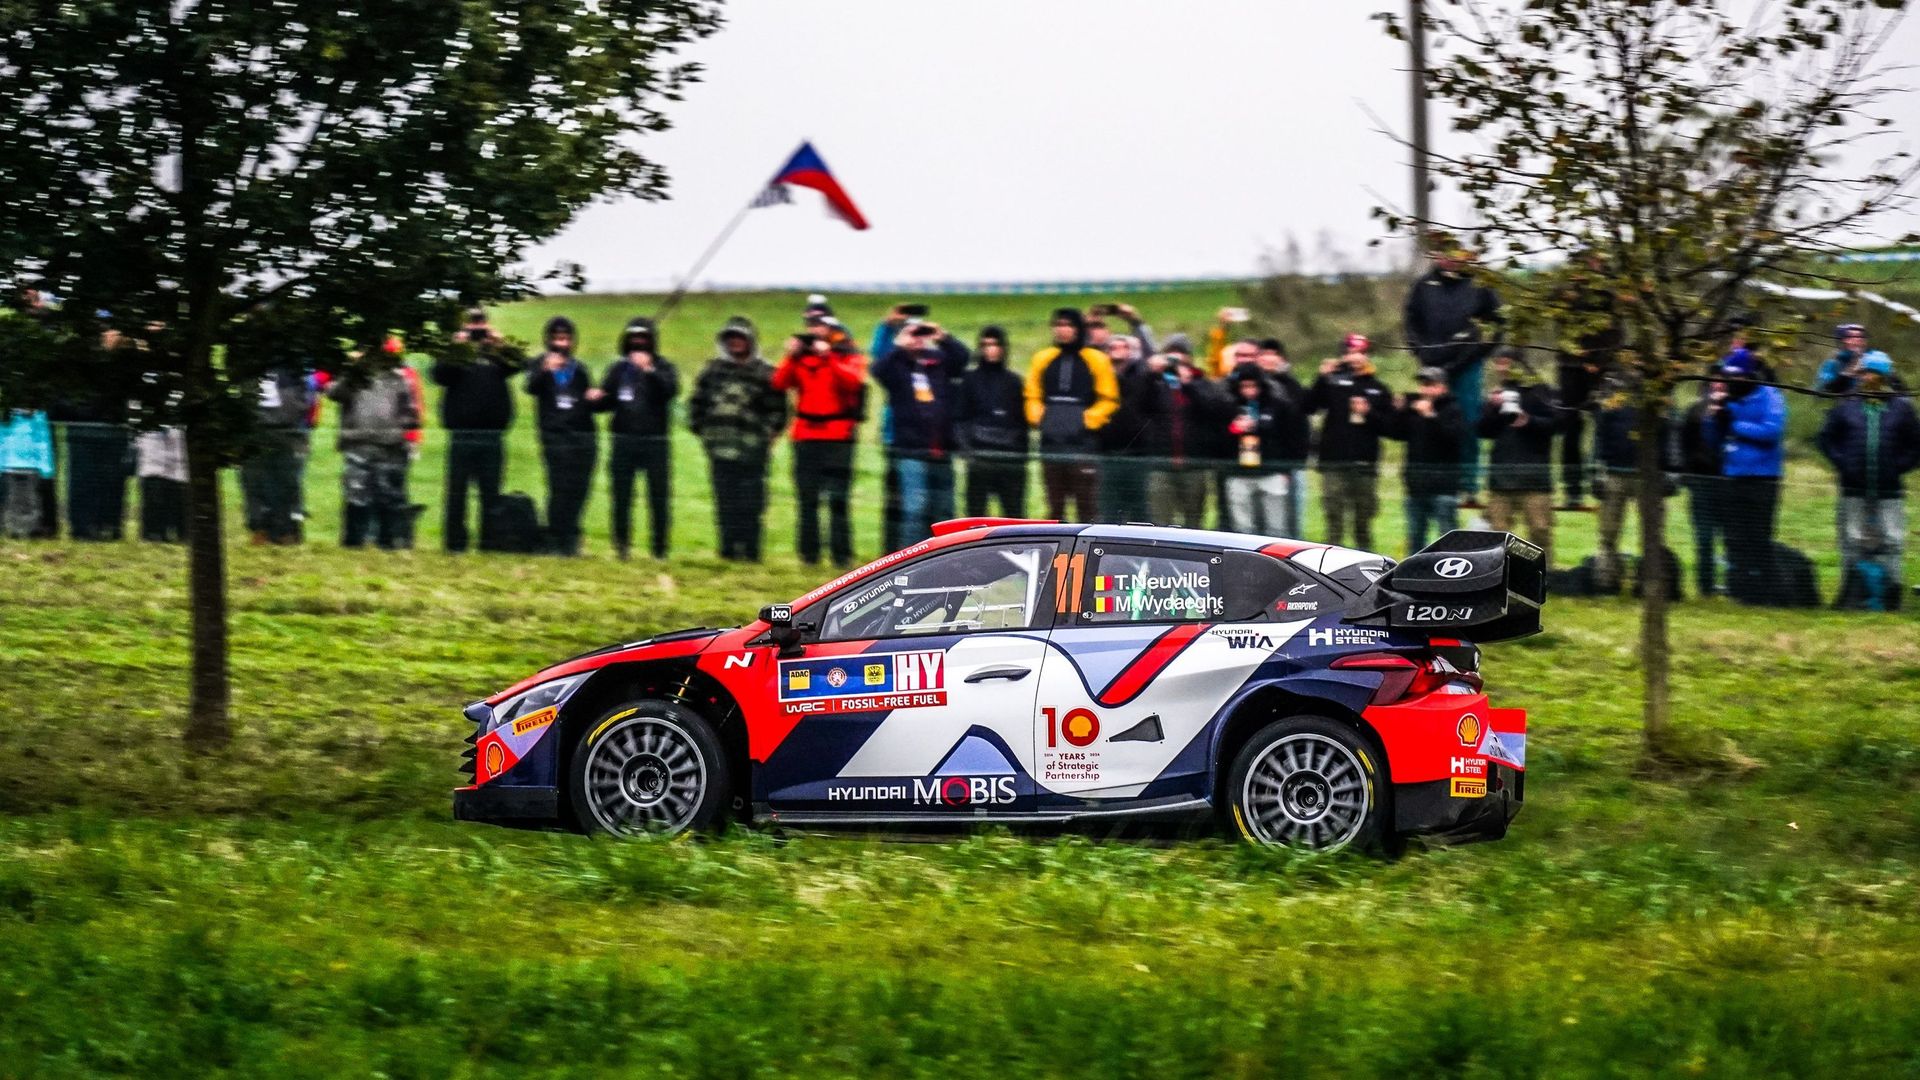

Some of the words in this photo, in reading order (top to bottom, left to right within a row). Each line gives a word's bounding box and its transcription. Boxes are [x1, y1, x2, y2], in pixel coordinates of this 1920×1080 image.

[808, 543, 929, 600] motorsport.hyundai.com
[859, 579, 894, 605] HYUNDAI
[1053, 553, 1085, 613] 11
[771, 606, 789, 619] ixo
[1335, 628, 1389, 638] HYUNDAI
[1335, 637, 1375, 645] STEEL
[790, 671, 809, 679] ADAC
[897, 652, 943, 691] HY
[786, 702, 826, 713] WRC
[841, 696, 910, 710] FOSSIL-FREE
[913, 694, 940, 705] FUEL
[516, 710, 553, 733] PIRELLI
[1046, 761, 1055, 770] of
[1058, 761, 1099, 771] Strategic
[1045, 772, 1100, 780] Partnership
[828, 786, 907, 801] HYUNDAI
[913, 776, 1017, 806] MOBIS
